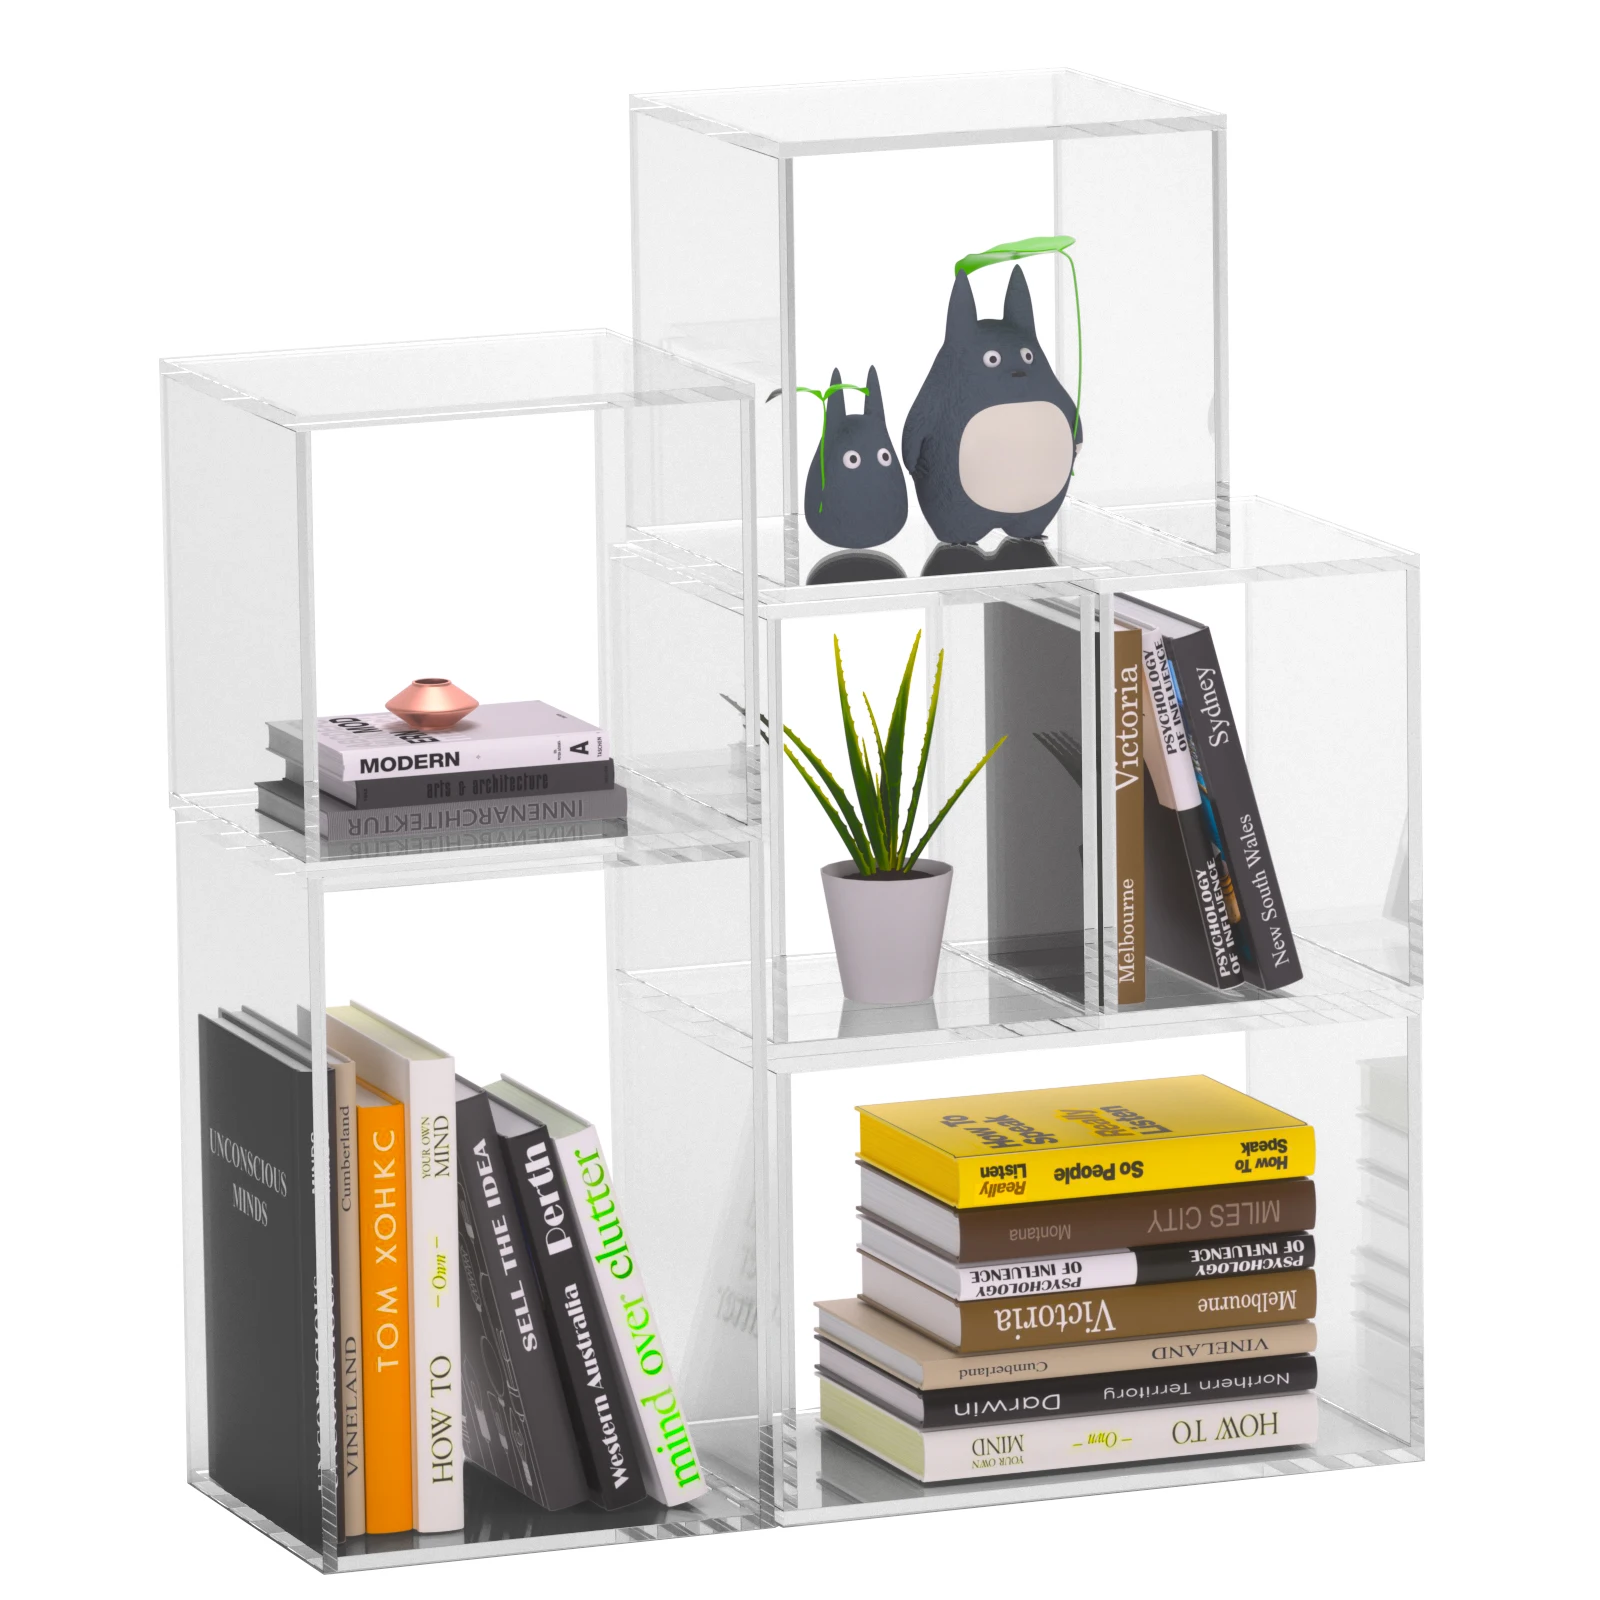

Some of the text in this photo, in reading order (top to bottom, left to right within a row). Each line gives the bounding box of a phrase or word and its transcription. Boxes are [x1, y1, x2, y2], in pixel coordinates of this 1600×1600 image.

[1143, 650, 1177, 755] PSYCHOLOGY
[1154, 638, 1187, 752] OF INFLUENCE
[1196, 667, 1230, 747] Sydney
[1114, 664, 1139, 791] Victoria
[360, 751, 460, 774] MODERN
[570, 740, 589, 755] A
[426, 780, 450, 799] arts
[472, 773, 549, 796] architecture
[348, 800, 583, 836] INNENARCHITEKTUR
[1240, 813, 1290, 968] New South Wales
[1119, 878, 1135, 984] Melbourne
[1196, 869, 1231, 978] PSYCHOLOGY
[1206, 858, 1241, 974] OF INFLUENCE
[940, 1114, 1023, 1149] How To
[983, 1114, 1059, 1146] Speak
[1059, 1109, 1135, 1138] Really
[1100, 1105, 1173, 1135] Listen
[209, 1127, 287, 1198] UNCONSCIOUS
[421, 1116, 431, 1179] YOUR OWN
[434, 1115, 449, 1177] MIND
[1241, 1138, 1288, 1156] Speak
[980, 1162, 1027, 1179] Listen
[1054, 1160, 1144, 1185] So People
[1235, 1156, 1288, 1173] How To
[232, 1182, 268, 1227] MINDS
[979, 1181, 1026, 1198] Really
[1009, 1224, 1071, 1242] Montana
[1147, 1199, 1280, 1234] MILES CITY
[472, 1137, 538, 1353] SELL THE IDEA
[1189, 1239, 1305, 1263] OF INFLUENCE
[432, 1254, 447, 1290] Own
[970, 1261, 1082, 1284] OF INFLUENCE
[1195, 1255, 1304, 1277] PSYCHOLOGY
[340, 1105, 358, 1477] VINELAND Cumberland
[976, 1277, 1082, 1298] PSYCHOLOGY
[525, 1141, 629, 1490] Western Australia Perth
[574, 1148, 701, 1489] mind over clutter
[994, 1289, 1297, 1340] Melbourne Victoria
[959, 1338, 1269, 1380] VINELAND Cumberland
[954, 1372, 1290, 1417] Northern Territory Darwin
[429, 1355, 453, 1484] HOW TO
[1172, 1411, 1278, 1445] HOW TO
[971, 1434, 1024, 1457] MIND
[1088, 1431, 1118, 1448] Own
[971, 1455, 1024, 1469] YOUR OWN
